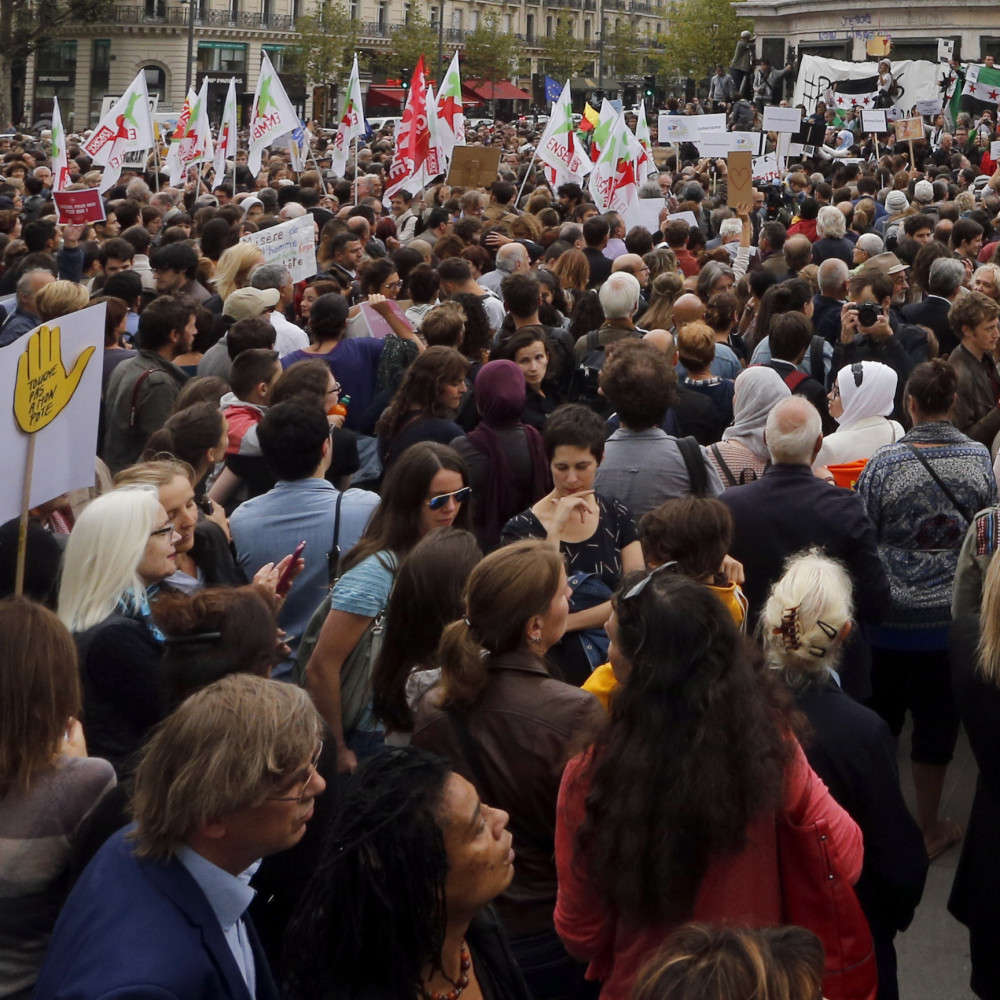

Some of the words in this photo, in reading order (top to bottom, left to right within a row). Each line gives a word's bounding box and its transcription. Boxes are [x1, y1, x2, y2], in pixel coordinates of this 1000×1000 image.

[290, 225, 300, 236] de
[27, 364, 57, 390] TOUCHE
[29, 384, 45, 403] PAS
[36, 384, 58, 409] MON
[30, 402, 53, 425] POTE
